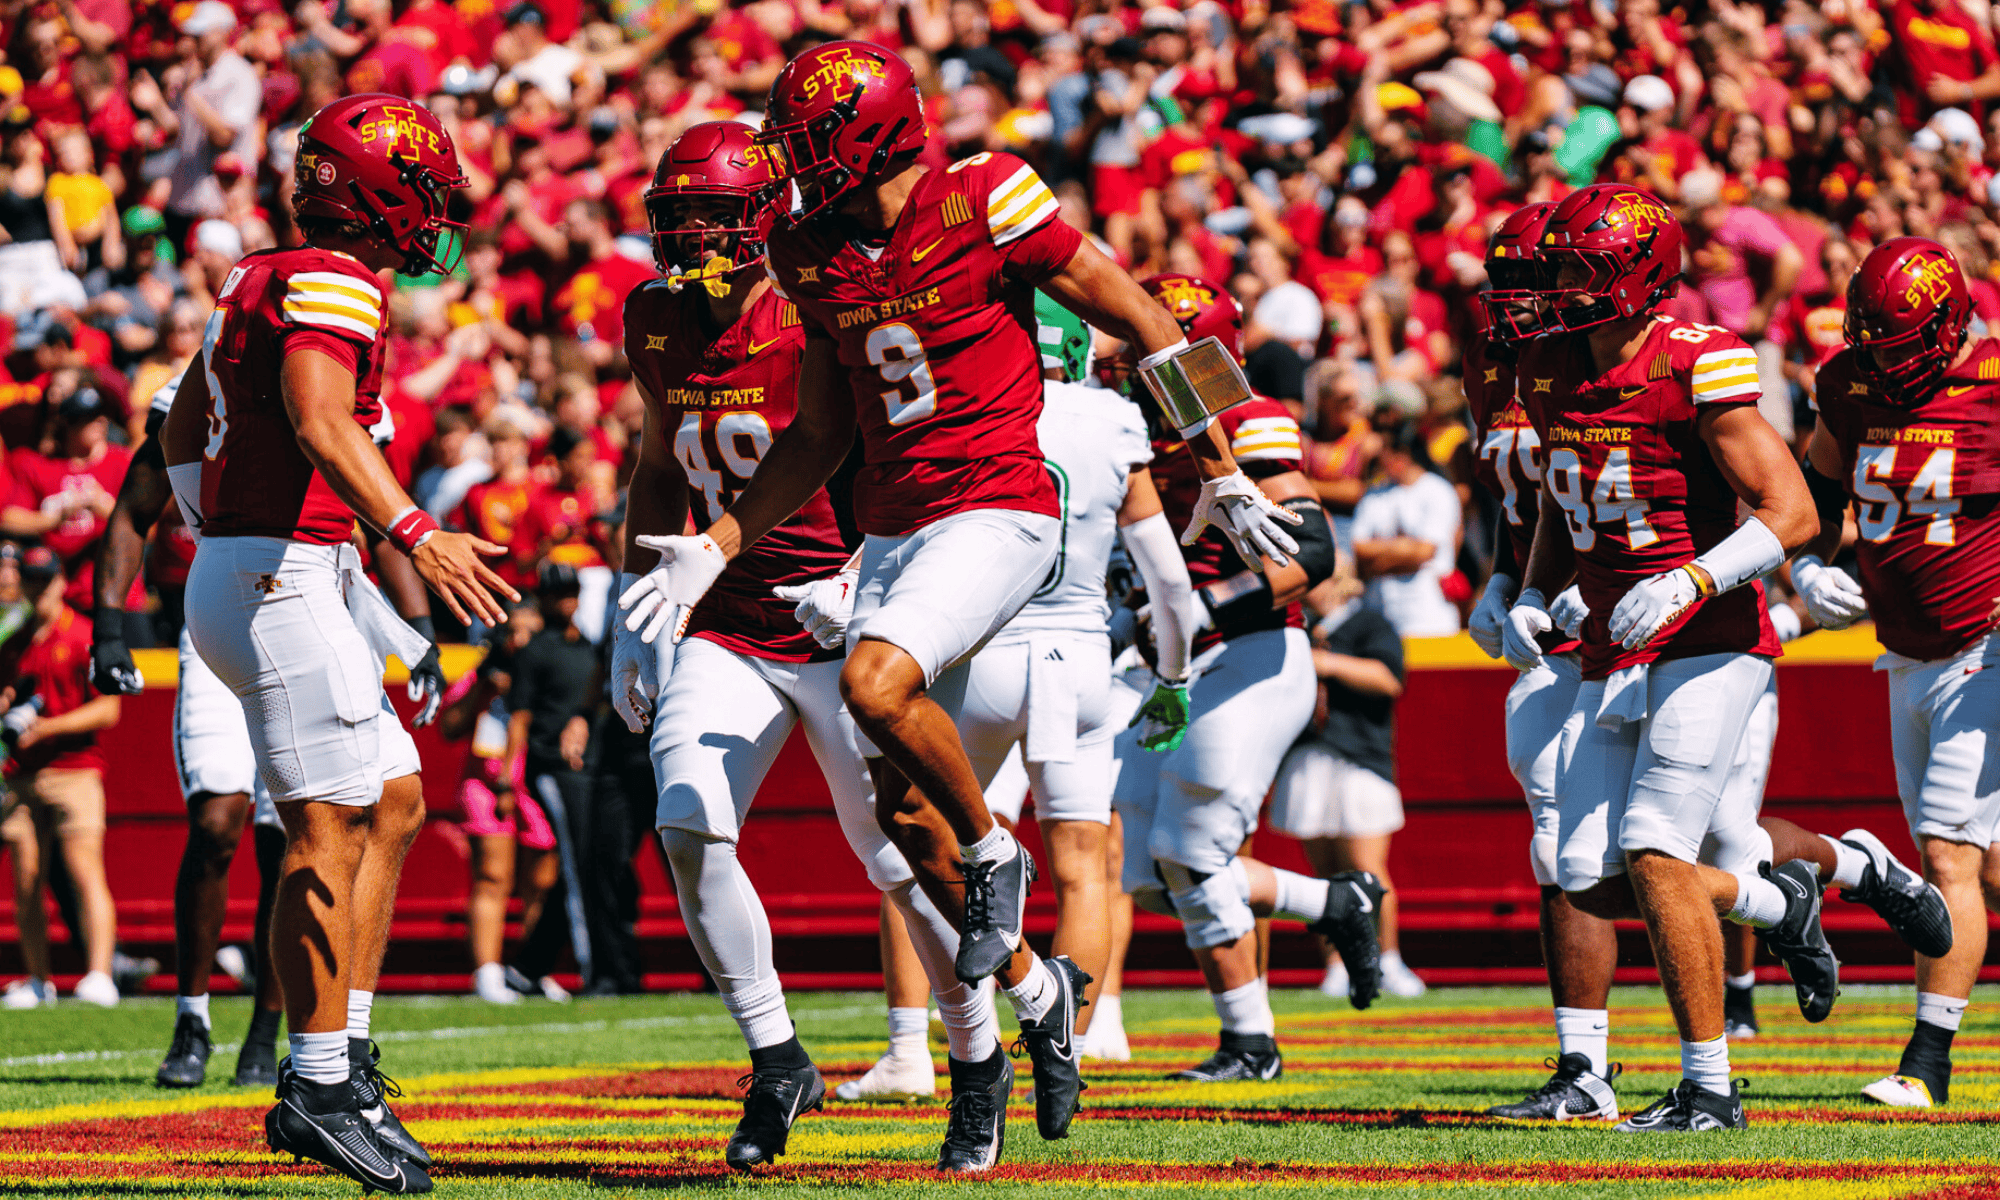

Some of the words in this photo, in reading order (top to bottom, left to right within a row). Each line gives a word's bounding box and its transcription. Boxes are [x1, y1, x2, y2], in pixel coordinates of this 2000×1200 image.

[803, 58, 886, 100] STATE
[361, 119, 440, 155] STATE
[1608, 202, 1670, 232] STATE
[797, 266, 820, 284] XII
[1905, 258, 1954, 309] STATE
[836, 305, 878, 329] IOWA
[880, 287, 941, 319] STATE
[645, 334, 668, 351] XII
[865, 322, 938, 427] 9
[1484, 366, 1498, 384] XII
[1533, 378, 1553, 393] XII
[667, 388, 706, 405] IOWA
[710, 386, 765, 406] STATE
[1549, 427, 1580, 442] IOWA
[1584, 427, 1632, 442] STATE
[1866, 428, 1900, 442] IOWA
[1903, 428, 1955, 444] STATE
[673, 410, 774, 525] 49
[1546, 446, 1661, 553] 84
[1853, 443, 1963, 547] 54
